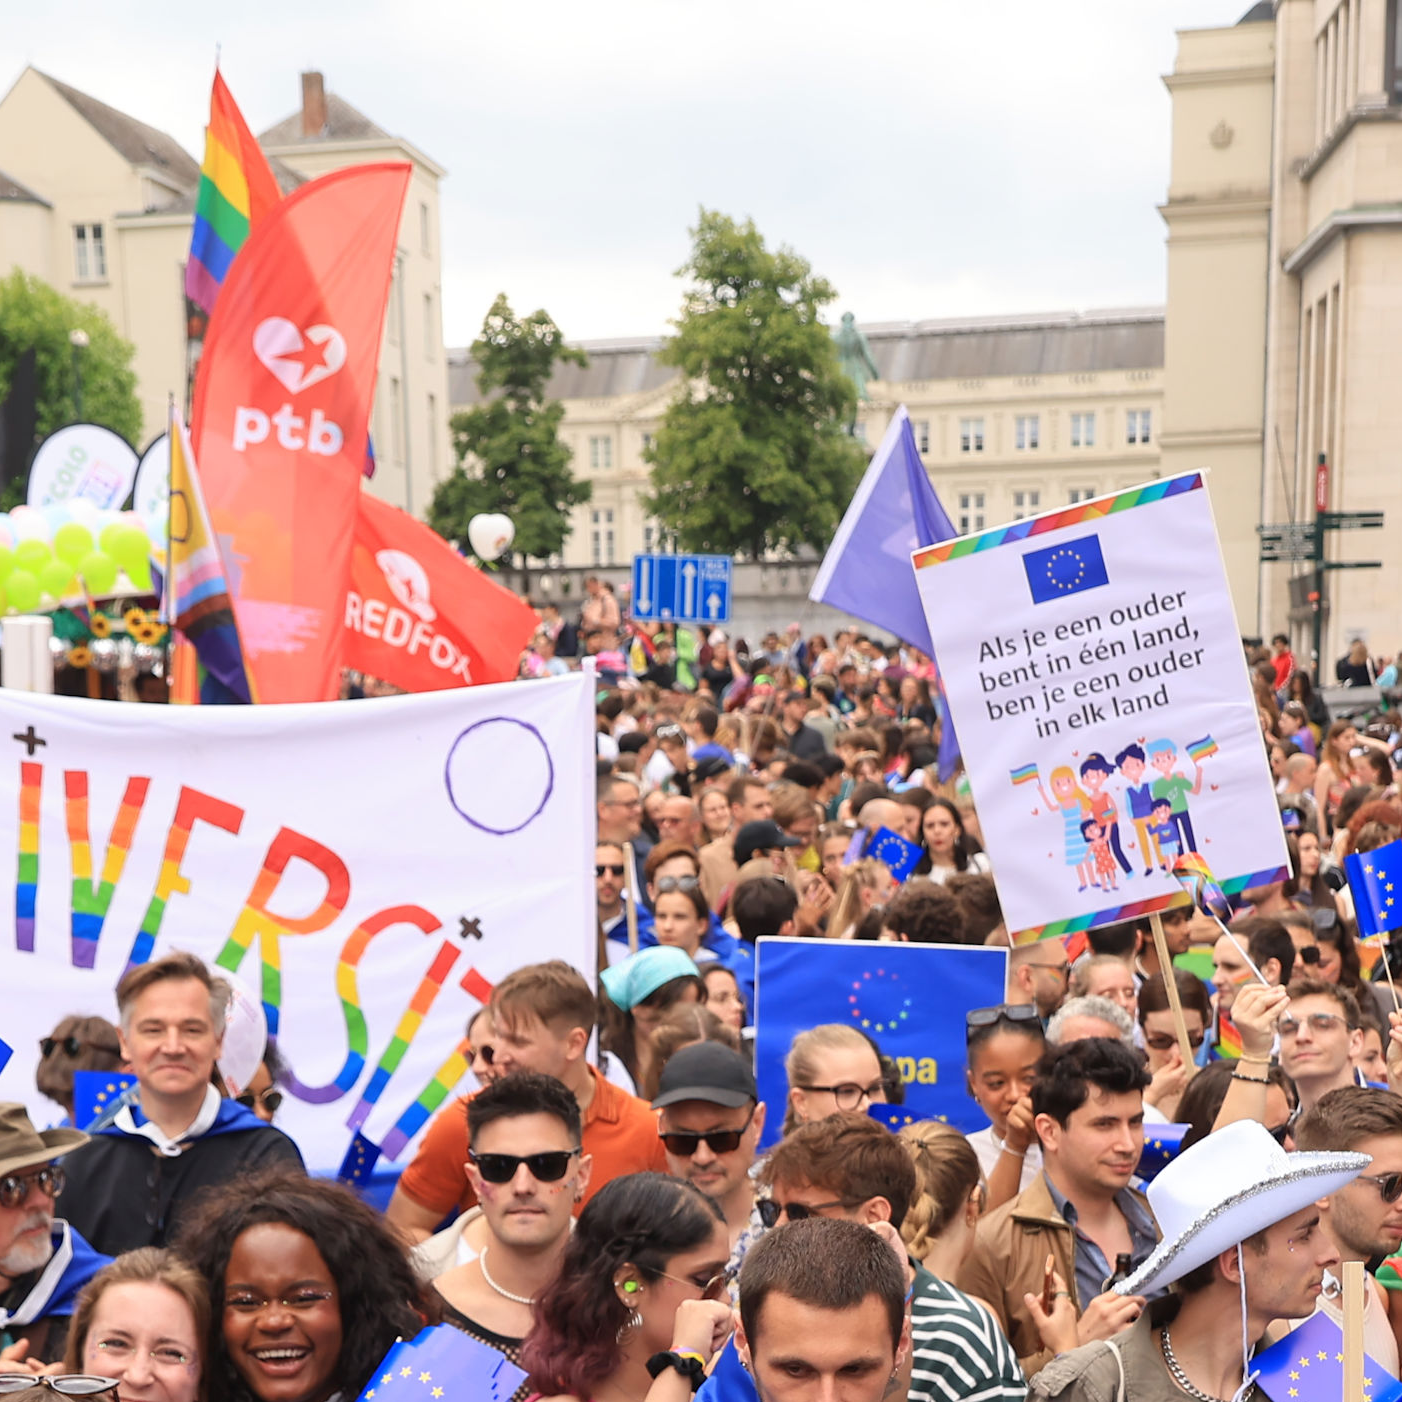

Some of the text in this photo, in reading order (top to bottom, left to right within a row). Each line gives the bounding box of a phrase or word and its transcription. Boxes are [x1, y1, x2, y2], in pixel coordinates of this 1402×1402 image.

[233, 402, 344, 456] ptb
[345, 591, 472, 685] REDFOX
[978, 590, 1187, 663] Als je een ouder
[979, 616, 1199, 693] bent in één land,
[986, 648, 1205, 721] ben je een ouder
[1036, 684, 1169, 738] in elk land
